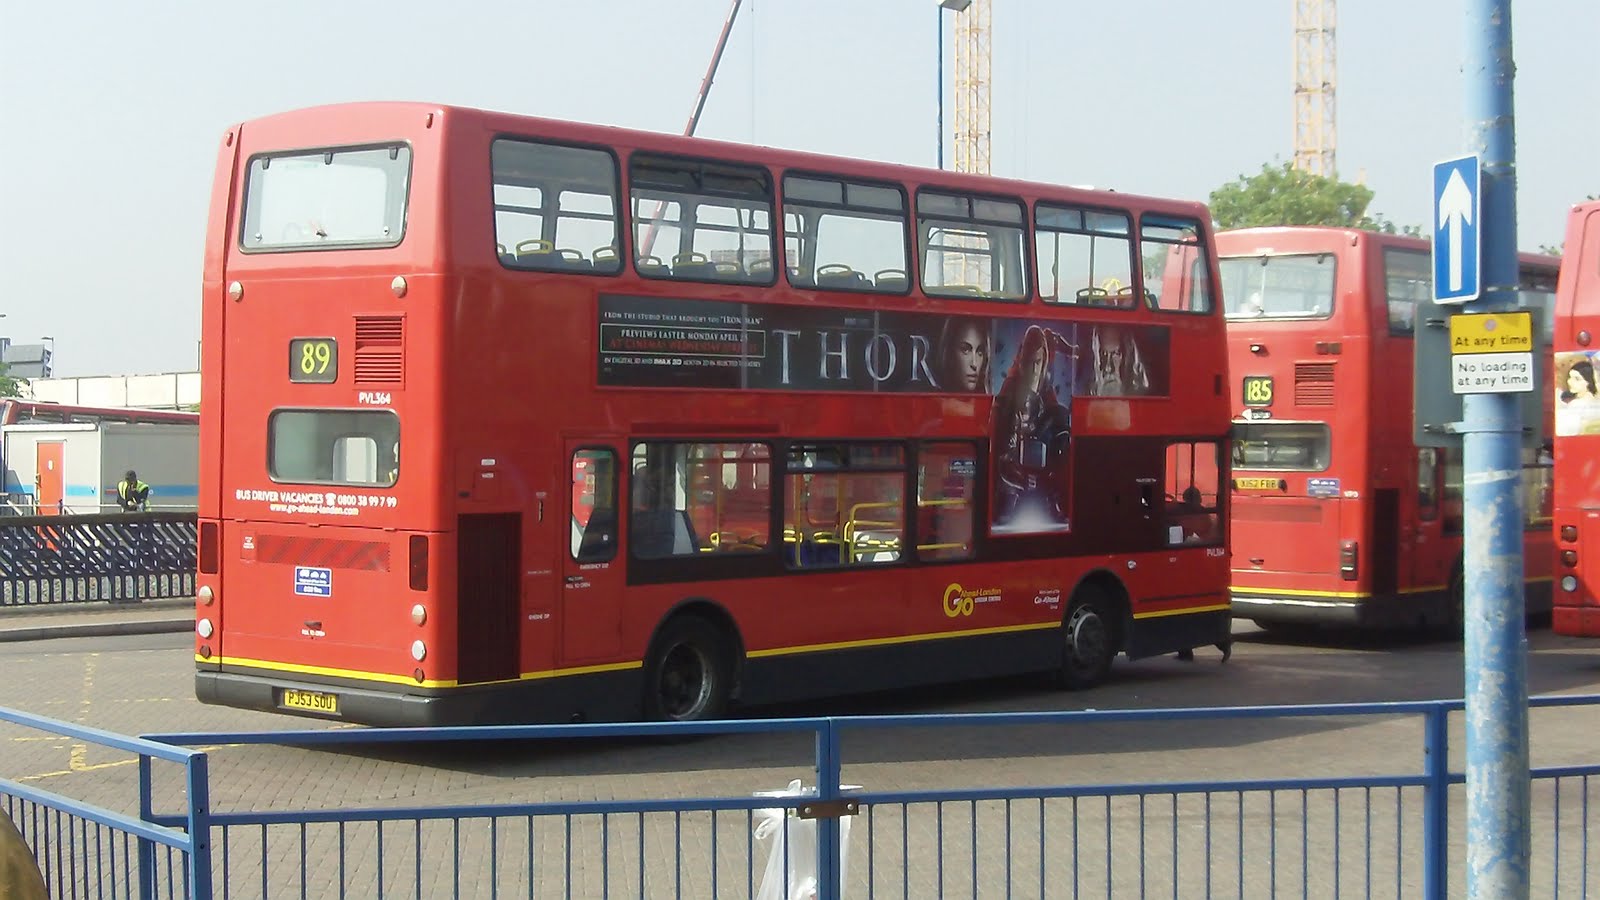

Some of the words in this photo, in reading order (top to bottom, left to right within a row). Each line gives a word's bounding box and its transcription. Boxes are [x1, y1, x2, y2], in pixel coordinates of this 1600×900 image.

[604, 311, 622, 319] FROM
[624, 312, 636, 320] THE
[637, 313, 661, 321] STUDIO
[621, 329, 658, 339] PREVIEWS
[659, 331, 686, 340] EASTER
[688, 332, 719, 341] MONDAY
[720, 333, 738, 342] APRIL
[1455, 337, 1470, 346] At
[1474, 337, 1497, 347] any
[1500, 335, 1528, 345] time
[301, 342, 331, 374] 89
[672, 358, 683, 366] 3D
[772, 329, 941, 389] THOR
[1459, 363, 1476, 373] No
[1481, 361, 1527, 373] loading
[1457, 377, 1470, 386] at
[1475, 377, 1497, 387] any
[1502, 375, 1529, 385] time
[1247, 380, 1272, 401] 185
[359, 391, 391, 405] PVL364
[235, 489, 251, 501] BUS
[252, 490, 279, 502] DRIVER
[280, 491, 324, 505] VACANCIES
[337, 494, 357, 506] 0800
[357, 495, 368, 507] 38
[368, 495, 379, 507] 99
[380, 496, 386, 507] 7
[386, 496, 397, 508] 99
[270, 503, 359, 516] www.go-ahead-london.com
[943, 582, 974, 618] Go
[288, 691, 312, 707] PJ53
[314, 694, 333, 709] SOU
